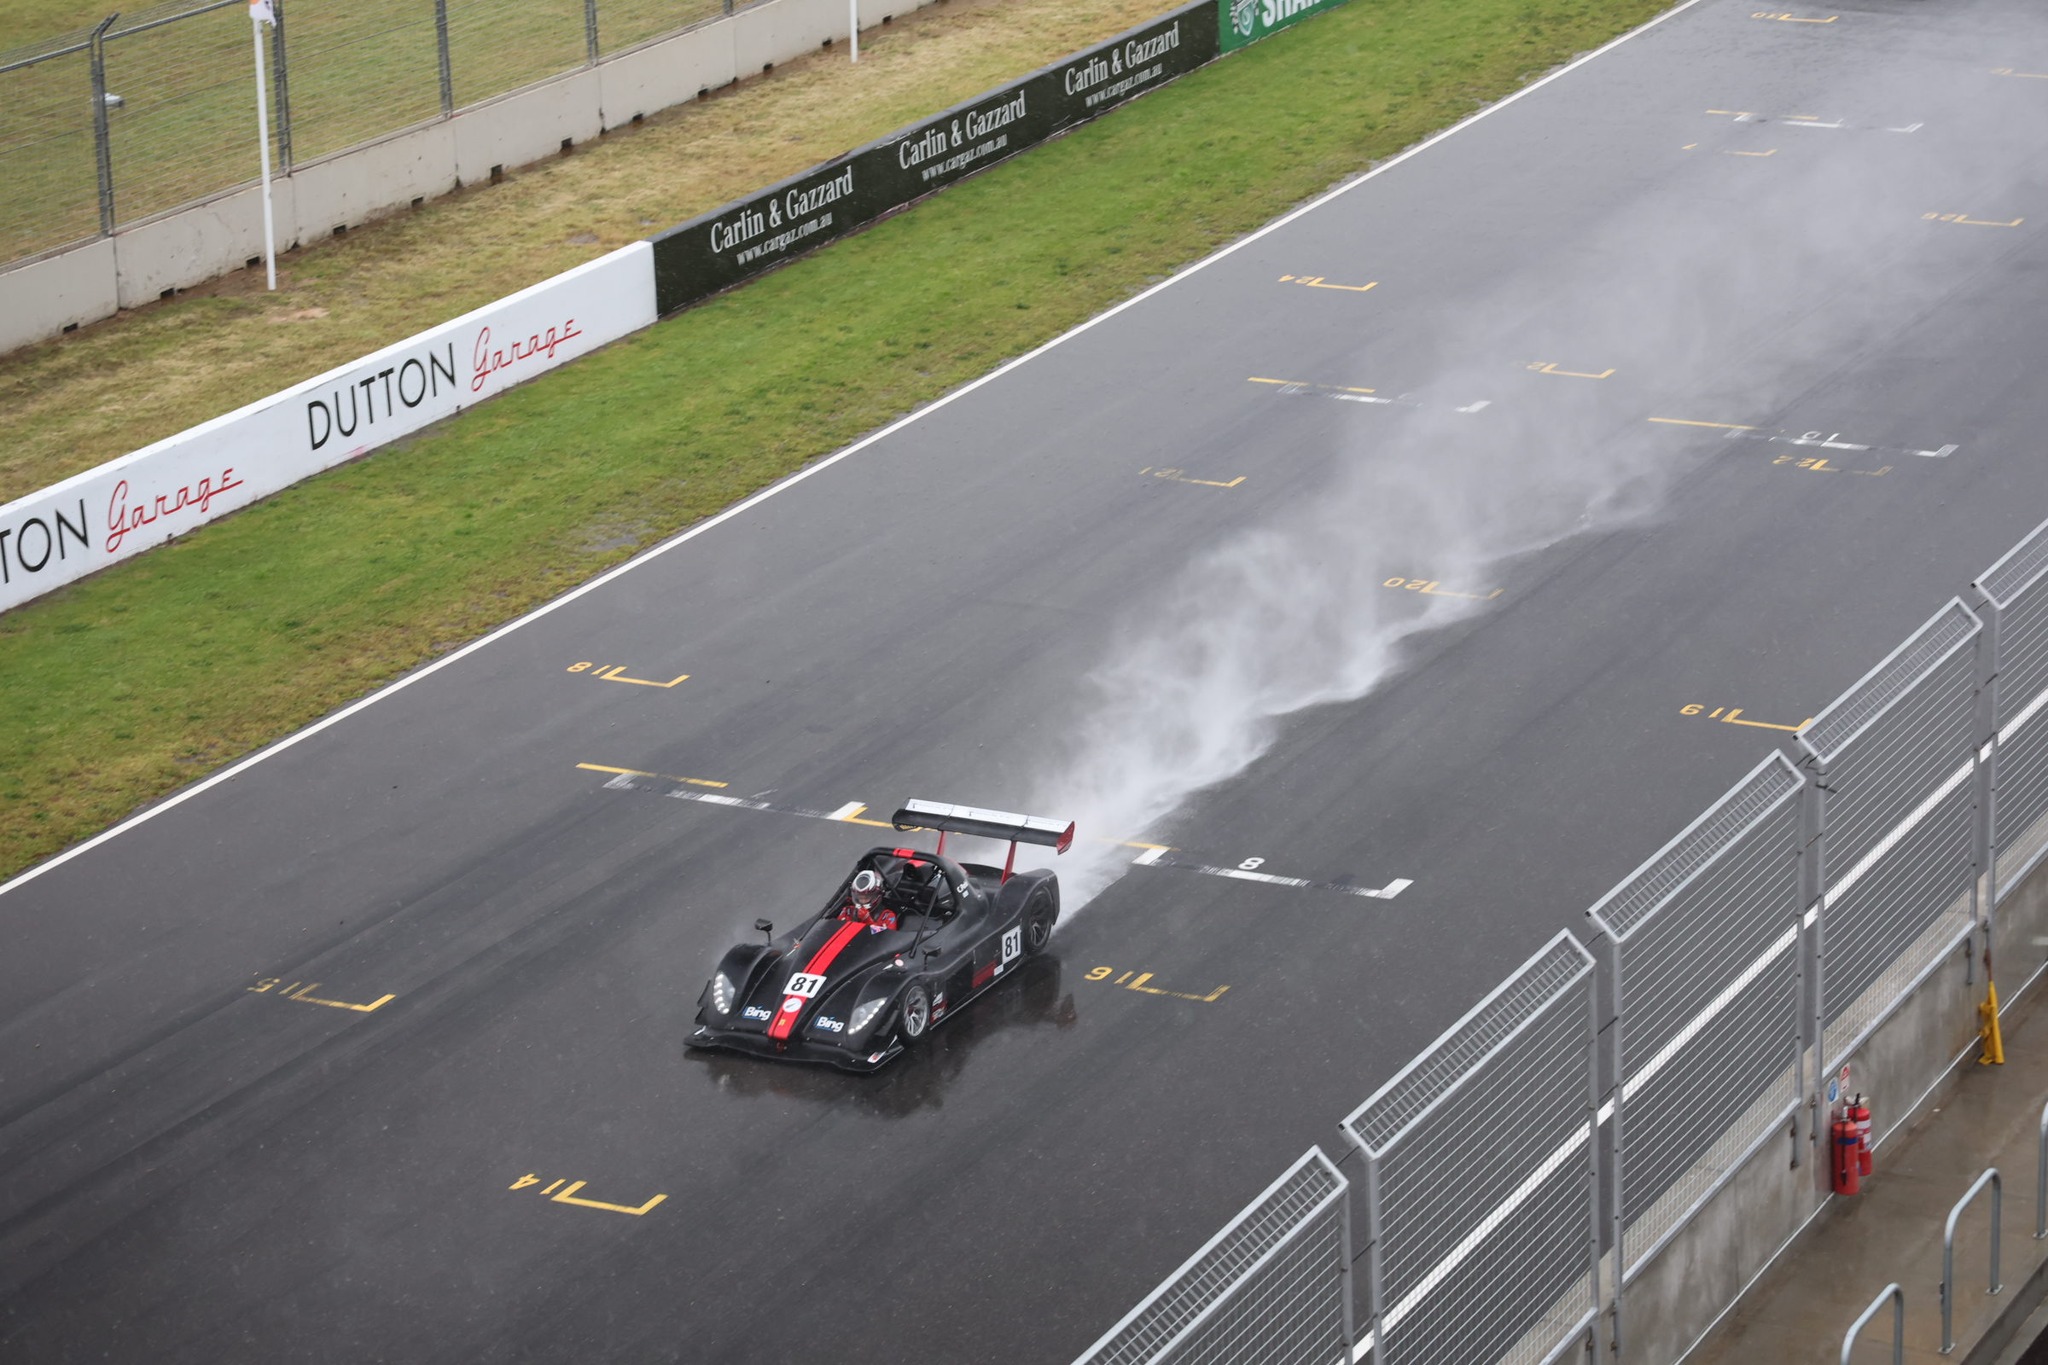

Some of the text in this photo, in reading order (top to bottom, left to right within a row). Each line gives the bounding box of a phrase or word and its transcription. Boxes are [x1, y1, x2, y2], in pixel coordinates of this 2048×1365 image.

[1065, 20, 1180, 96] Carlin & Gazzard
[1085, 63, 1163, 108] www.cargaz.com.au
[900, 89, 1026, 170] Carlin & Gazzard
[921, 133, 1008, 182] www.cargaz.com.au
[711, 165, 854, 253] Carlin & Gazzard
[736, 212, 833, 266] www.cargaz.com.au
[308, 319, 582, 451] DUTTON Garage
[106, 468, 243, 553] Garage
[1238, 856, 1265, 870] 8
[1005, 931, 1018, 957] 81
[791, 976, 819, 994] 81
[744, 1006, 772, 1021] Bing
[817, 1016, 845, 1033] Bing
